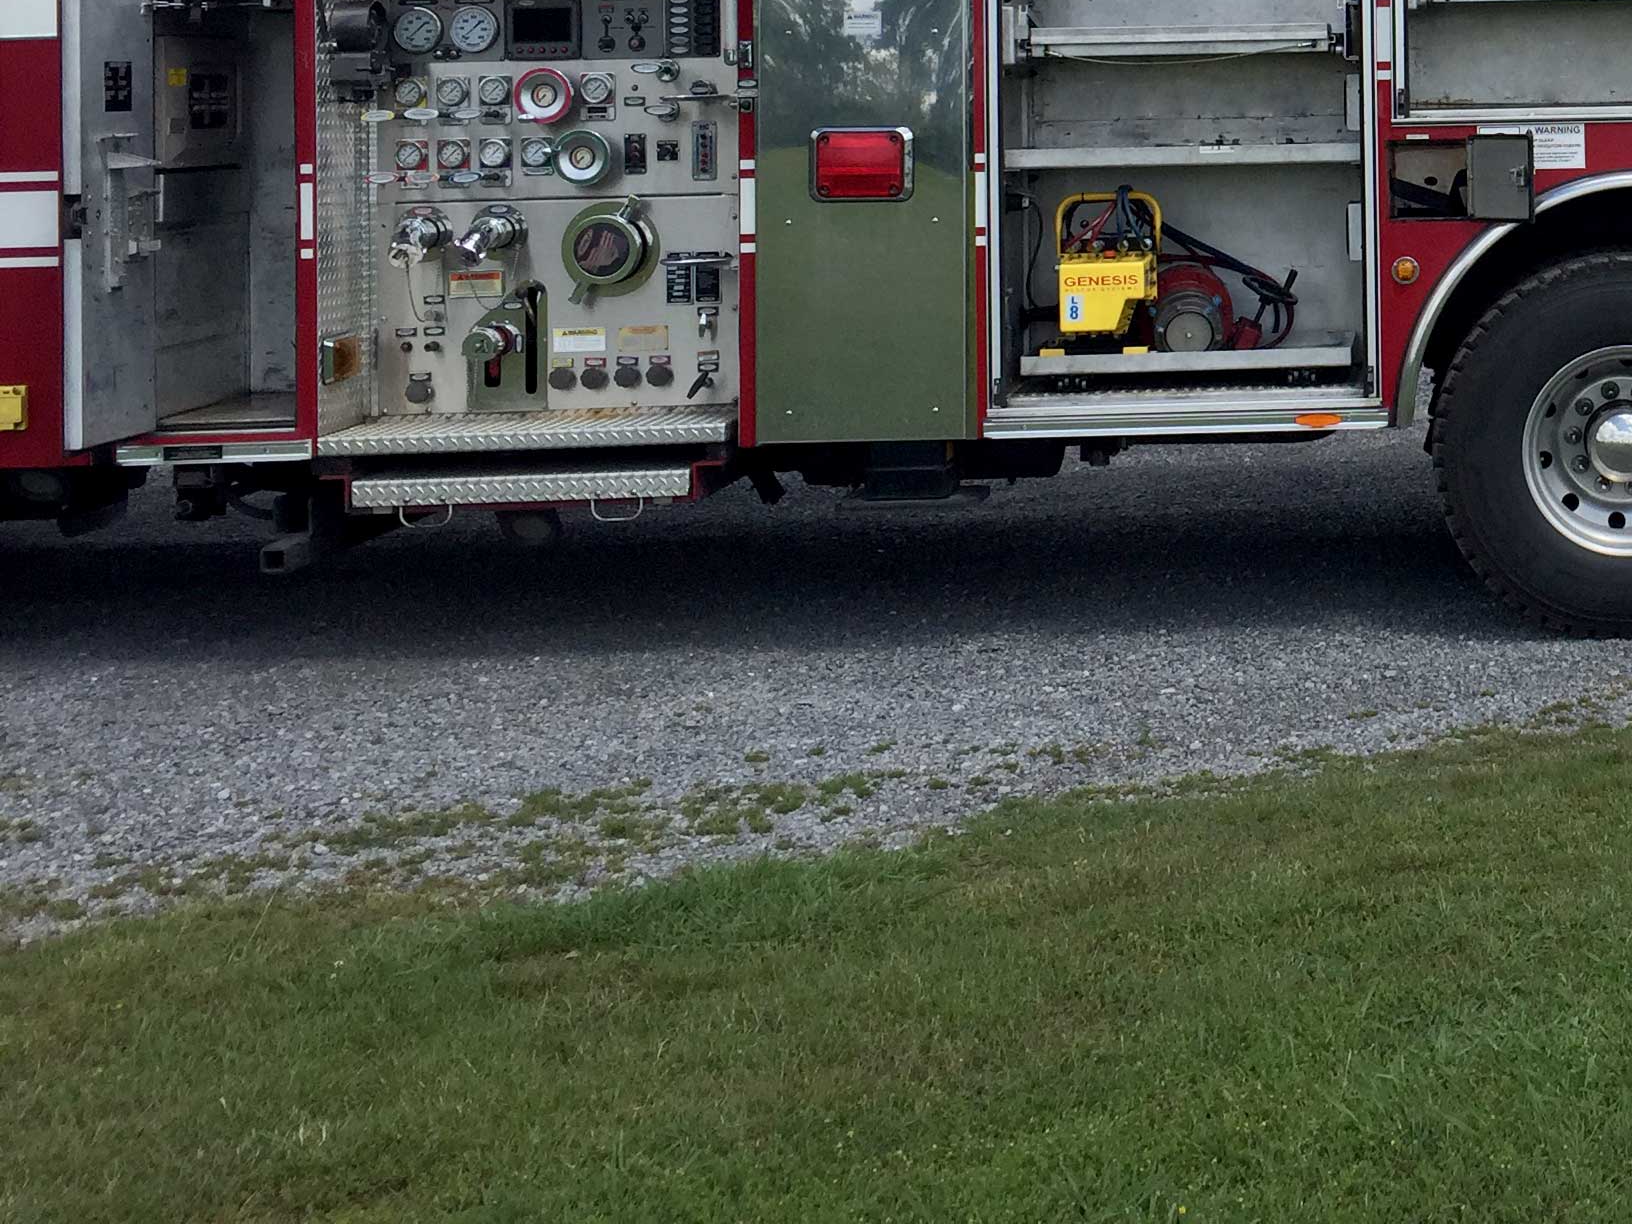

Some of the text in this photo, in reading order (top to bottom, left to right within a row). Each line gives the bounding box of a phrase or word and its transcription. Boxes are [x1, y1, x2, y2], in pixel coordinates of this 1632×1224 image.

[1534, 125, 1581, 135] WARNING
[1063, 275, 1138, 287] GENESIS
[1071, 296, 1078, 305] L
[1069, 305, 1079, 320] 8
